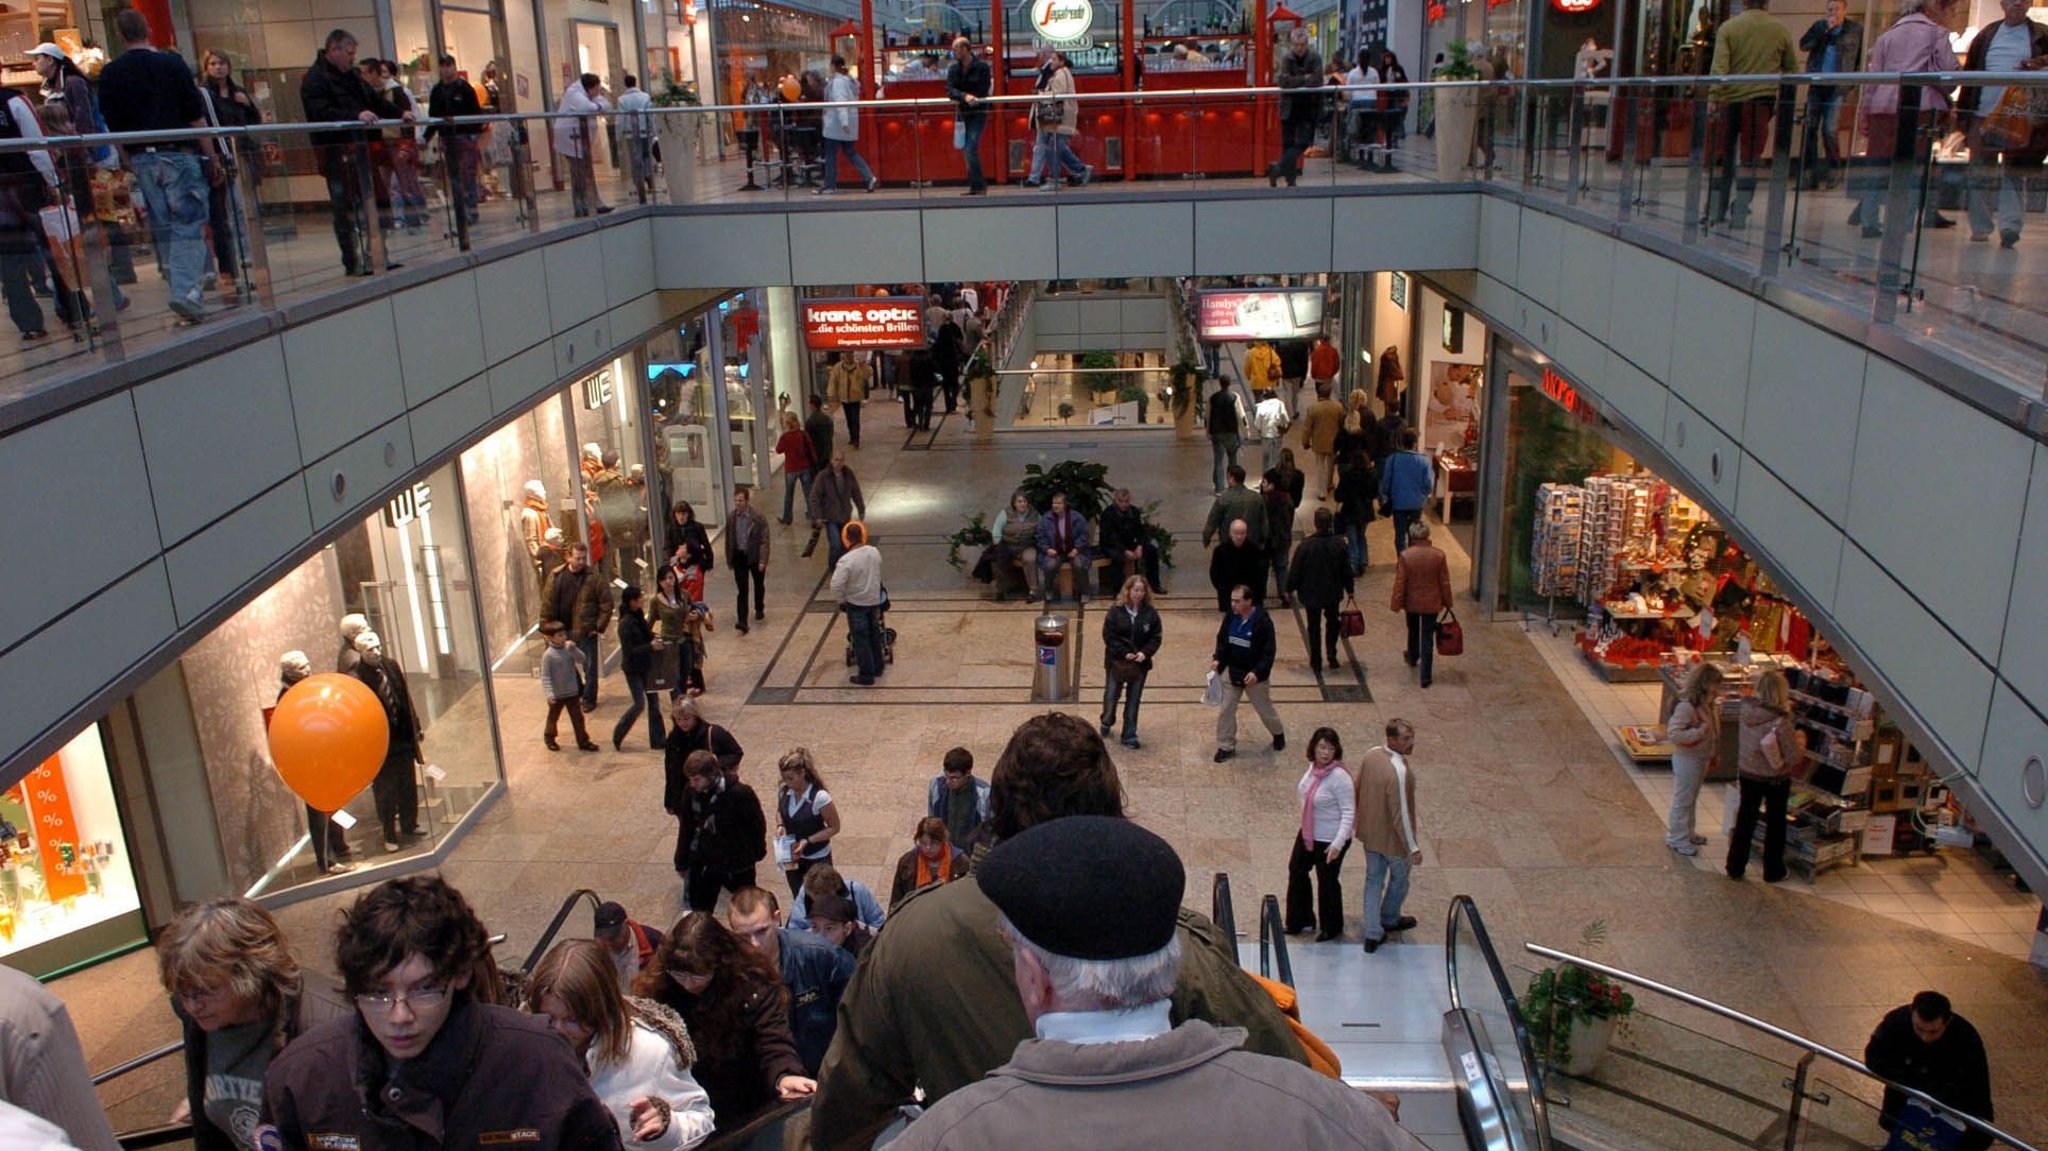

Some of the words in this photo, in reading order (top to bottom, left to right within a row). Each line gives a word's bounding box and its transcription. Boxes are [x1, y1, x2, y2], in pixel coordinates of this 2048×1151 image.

[807, 308, 863, 323] krane
[866, 308, 918, 324] optic
[836, 322, 884, 333] schönsten
[886, 321, 919, 332] Brillen
[586, 371, 613, 410] WE
[389, 481, 432, 528] WE
[37, 788, 57, 804] %
[43, 812, 63, 828] %
